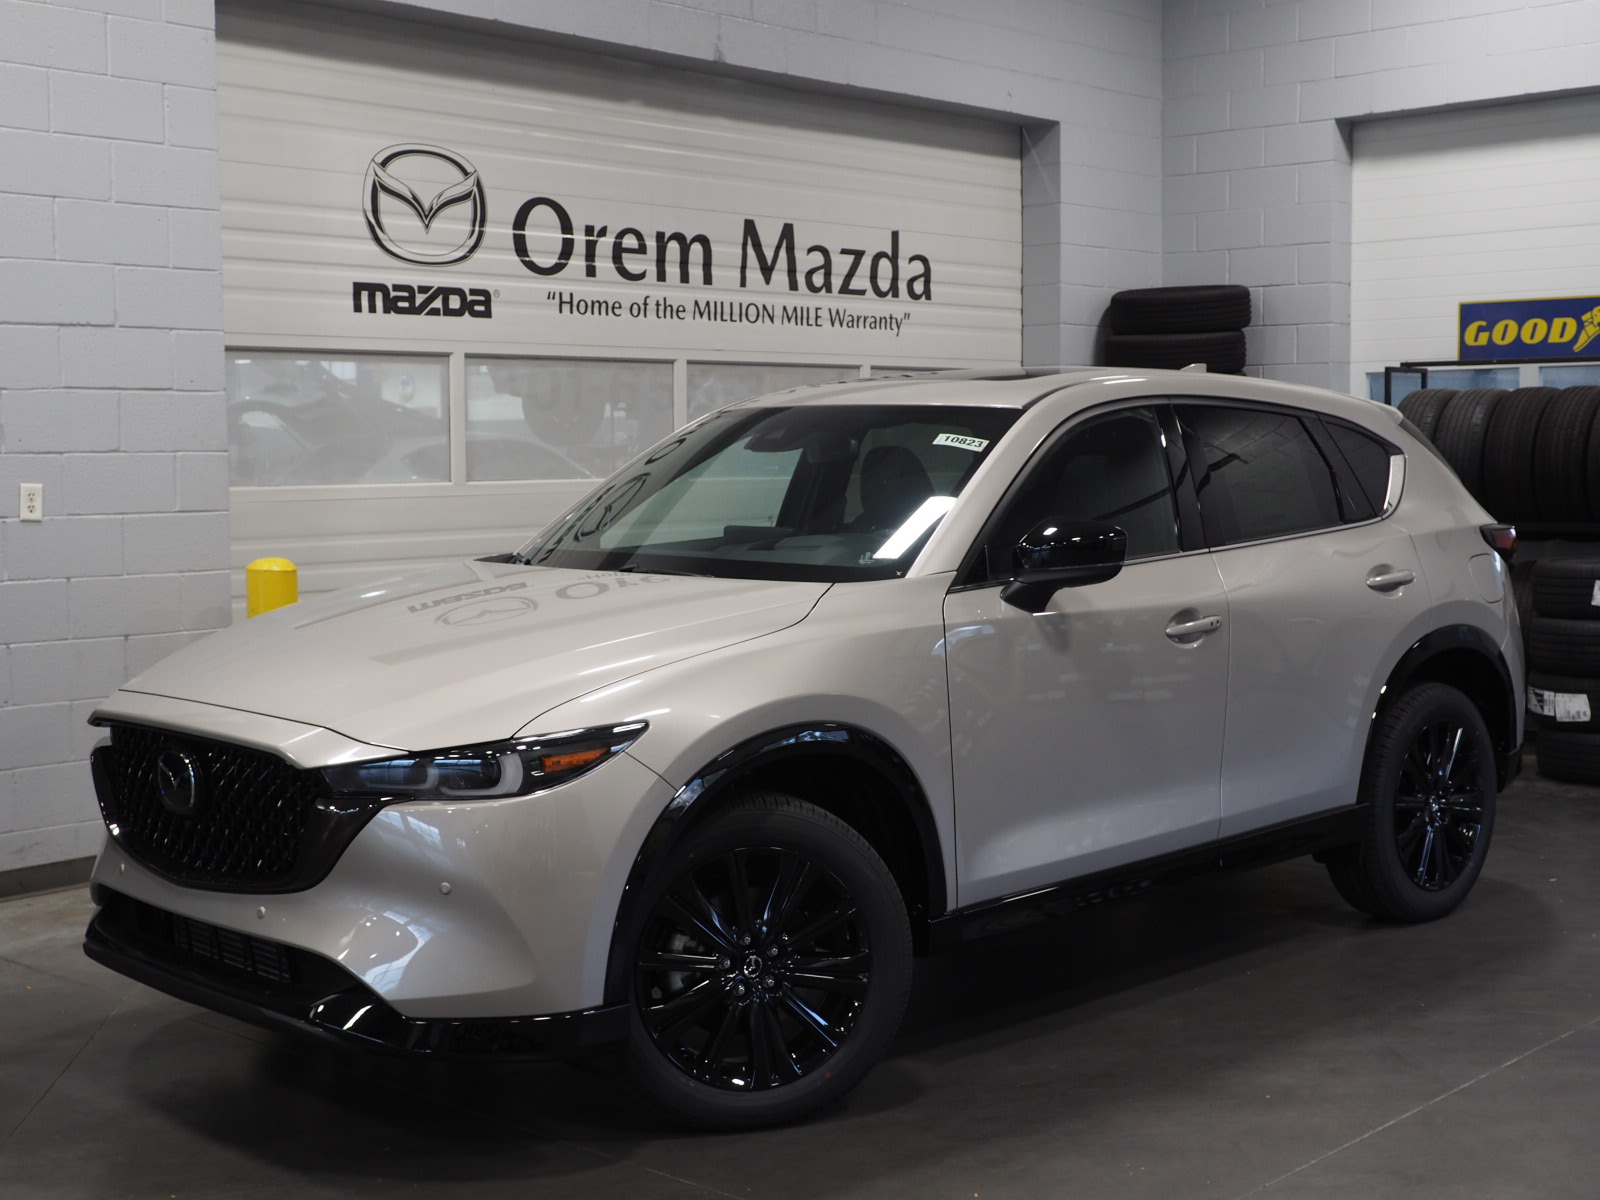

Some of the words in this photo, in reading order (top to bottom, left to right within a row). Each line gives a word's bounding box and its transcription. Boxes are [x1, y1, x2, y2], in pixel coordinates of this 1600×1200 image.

[512, 196, 713, 286] Orem
[739, 218, 932, 301] Mazda
[629, 295, 650, 319] of
[655, 297, 686, 321] the
[692, 299, 775, 325] MILLION
[781, 305, 823, 327] MILE
[1464, 316, 1578, 346] GOOD
[944, 435, 984, 448] 10823
